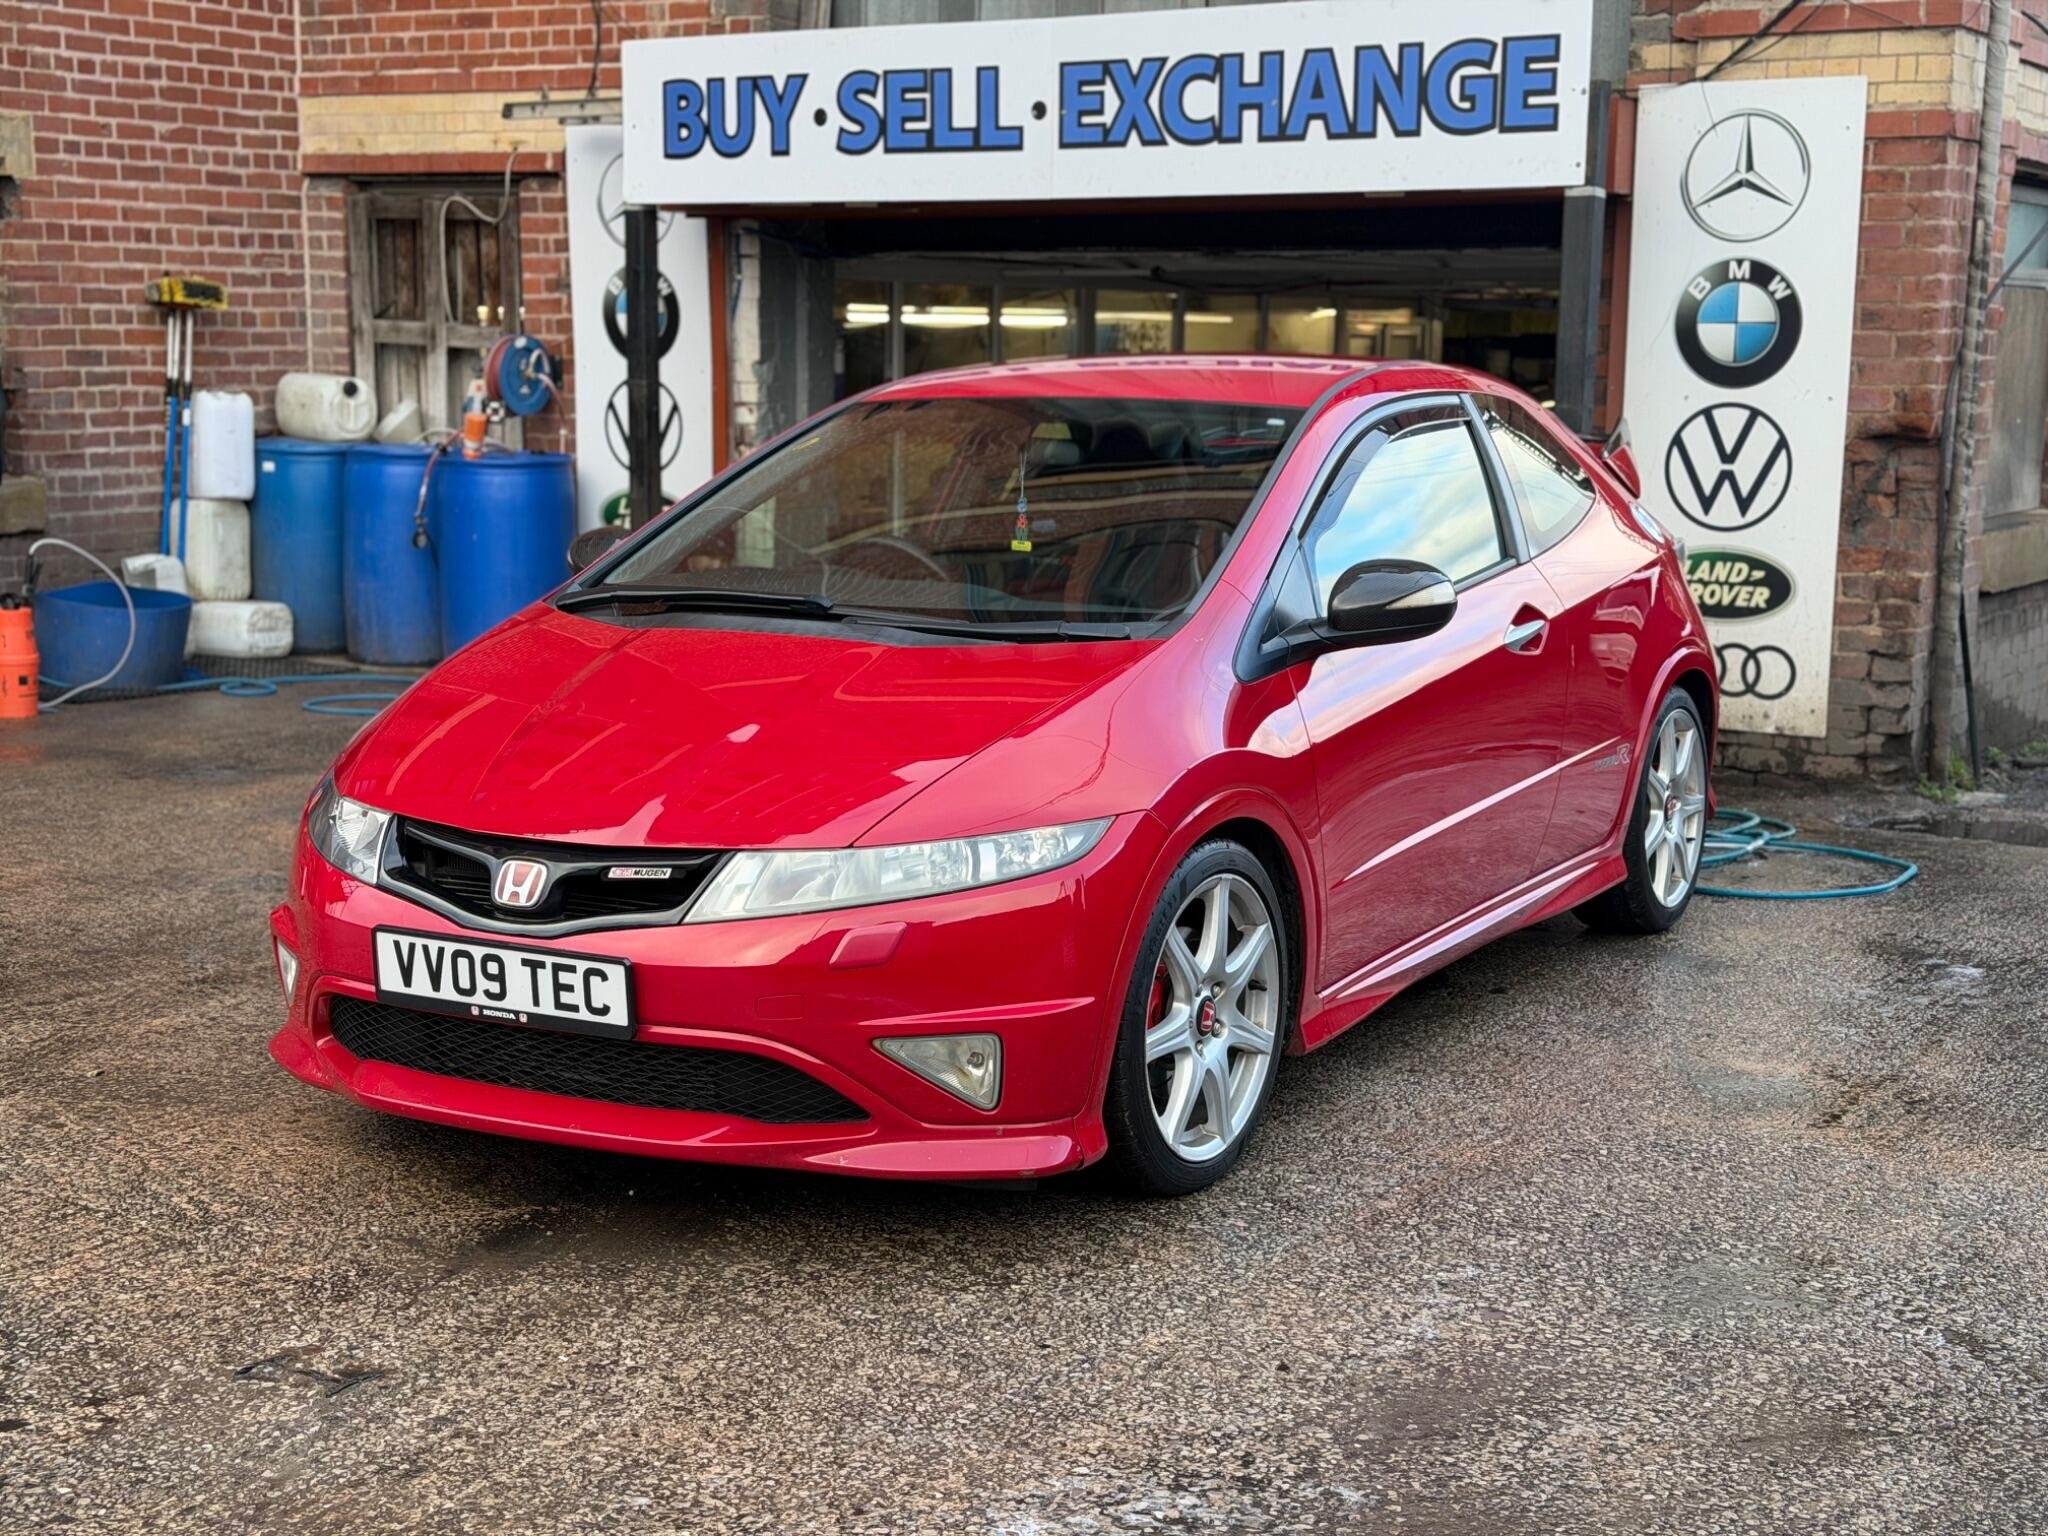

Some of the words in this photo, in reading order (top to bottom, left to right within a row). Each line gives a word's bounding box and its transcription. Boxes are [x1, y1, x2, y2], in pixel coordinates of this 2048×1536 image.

[662, 73, 809, 159] BUY
[836, 66, 1024, 154] SELL
[1058, 34, 1561, 149] EXCHANGE
[1687, 260, 1792, 301] BMW
[633, 869, 668, 877] MUGEN
[392, 939, 508, 1003] VV09
[520, 957, 611, 1018] TEC
[482, 1008, 517, 1020] HONDA
